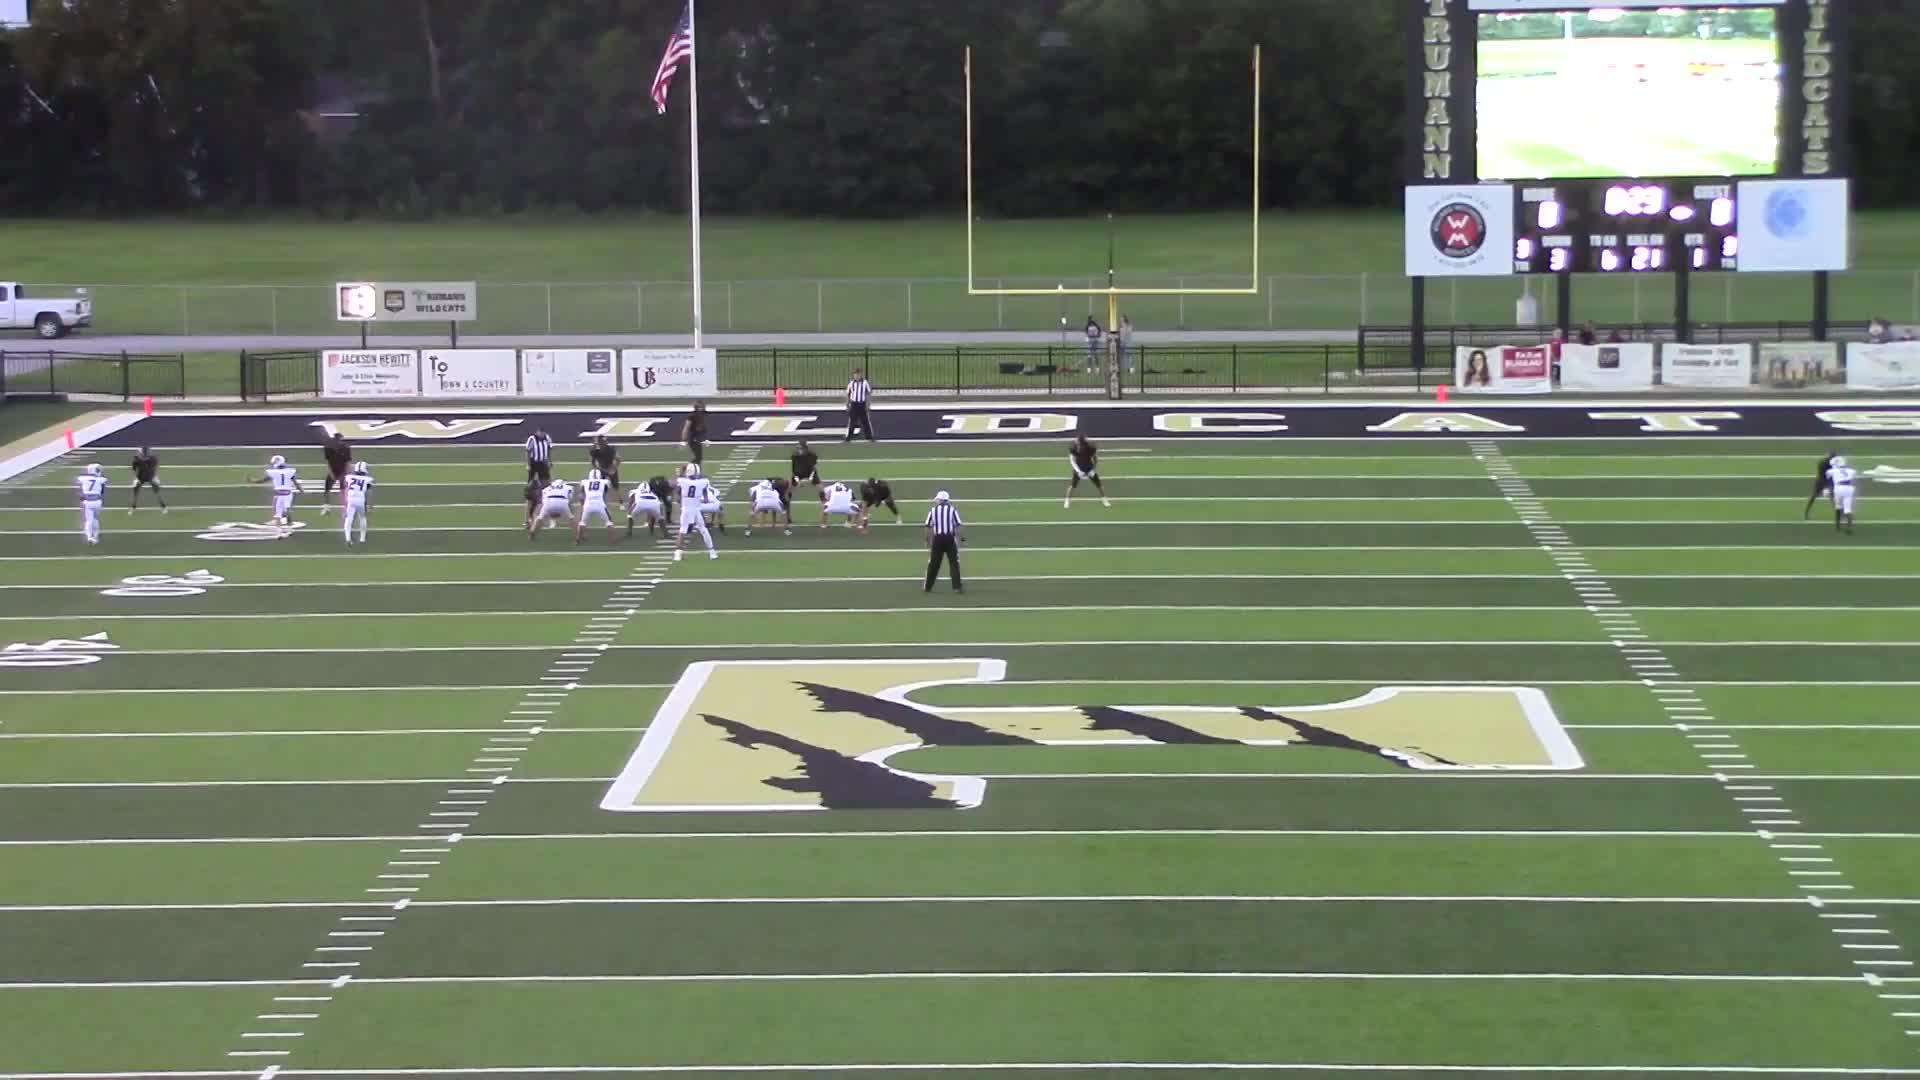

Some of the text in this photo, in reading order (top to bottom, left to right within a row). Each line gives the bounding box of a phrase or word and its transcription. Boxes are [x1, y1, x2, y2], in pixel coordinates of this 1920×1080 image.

[1423, 0, 1451, 178] TRUMANN
[1802, 0, 1832, 174] ILDCATS
[1446, 215, 1469, 229] W
[1550, 247, 1565, 271] 3
[1631, 247, 1661, 271] 21
[1693, 247, 1704, 268] 1
[415, 304, 466, 312] WILDCATS
[340, 353, 411, 365] JACKSON HEWITT
[472, 380, 509, 389] COUNTRY
[88, 479, 97, 491] 7
[350, 478, 364, 491] 24
[588, 481, 600, 491] 18
